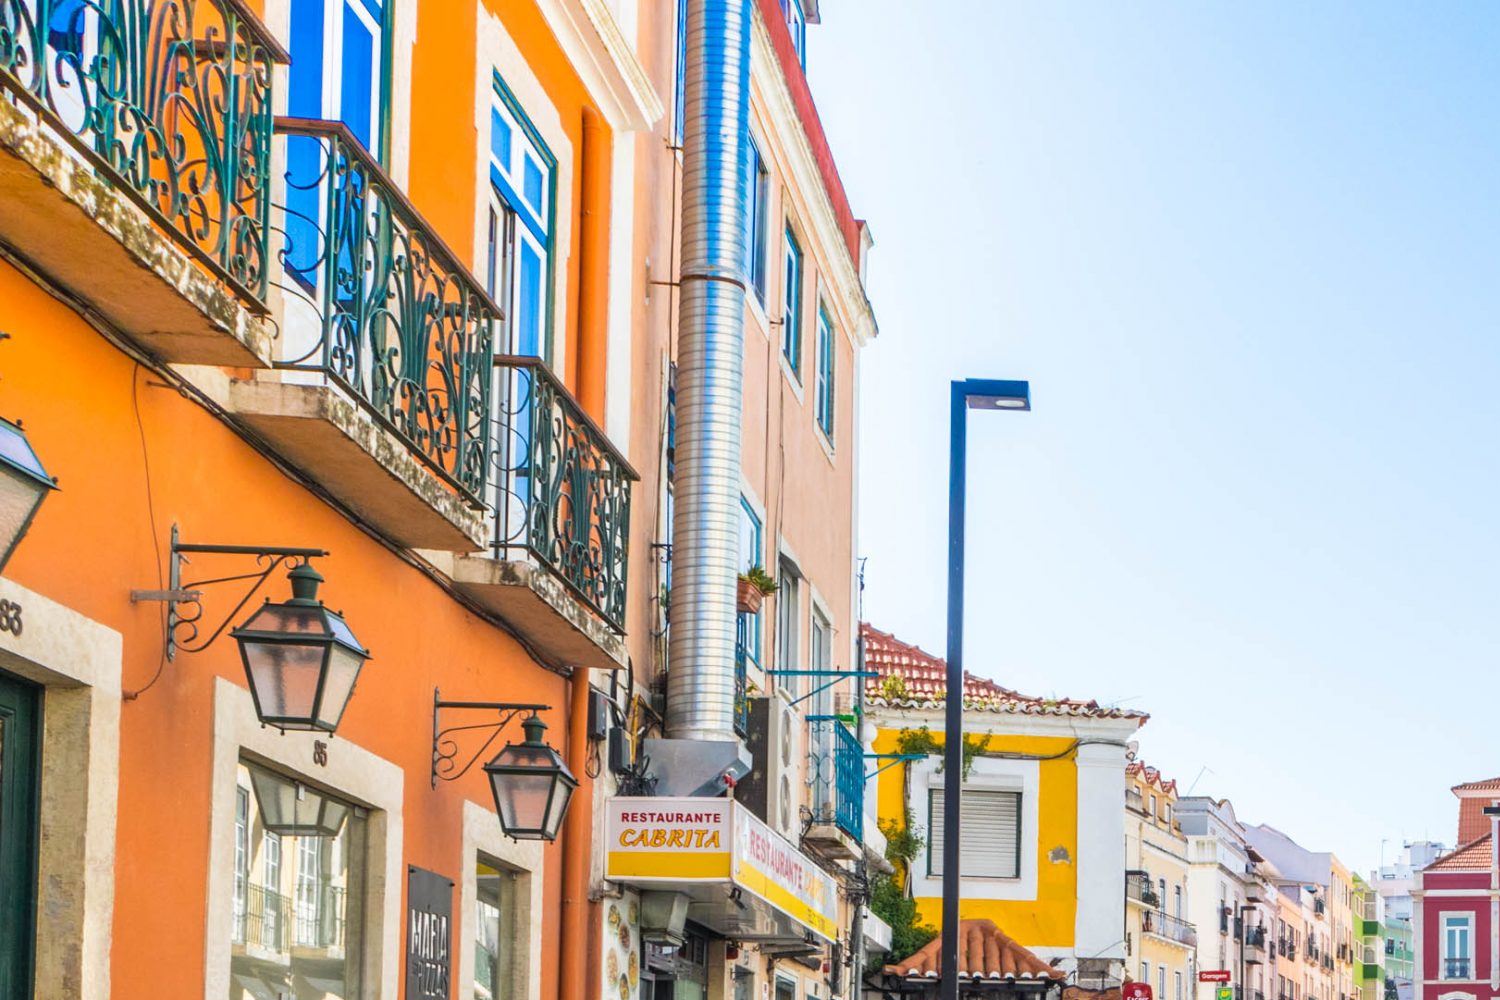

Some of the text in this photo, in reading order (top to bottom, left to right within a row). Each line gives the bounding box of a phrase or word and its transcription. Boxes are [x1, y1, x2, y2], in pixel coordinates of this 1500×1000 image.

[0, 599, 23, 637] 83
[313, 740, 328, 767] 85
[621, 812, 721, 823] RESTAURANTE
[619, 828, 721, 849] CABRITA
[750, 830, 803, 890] RESTAURANTE
[417, 961, 448, 999] PIZZAS
